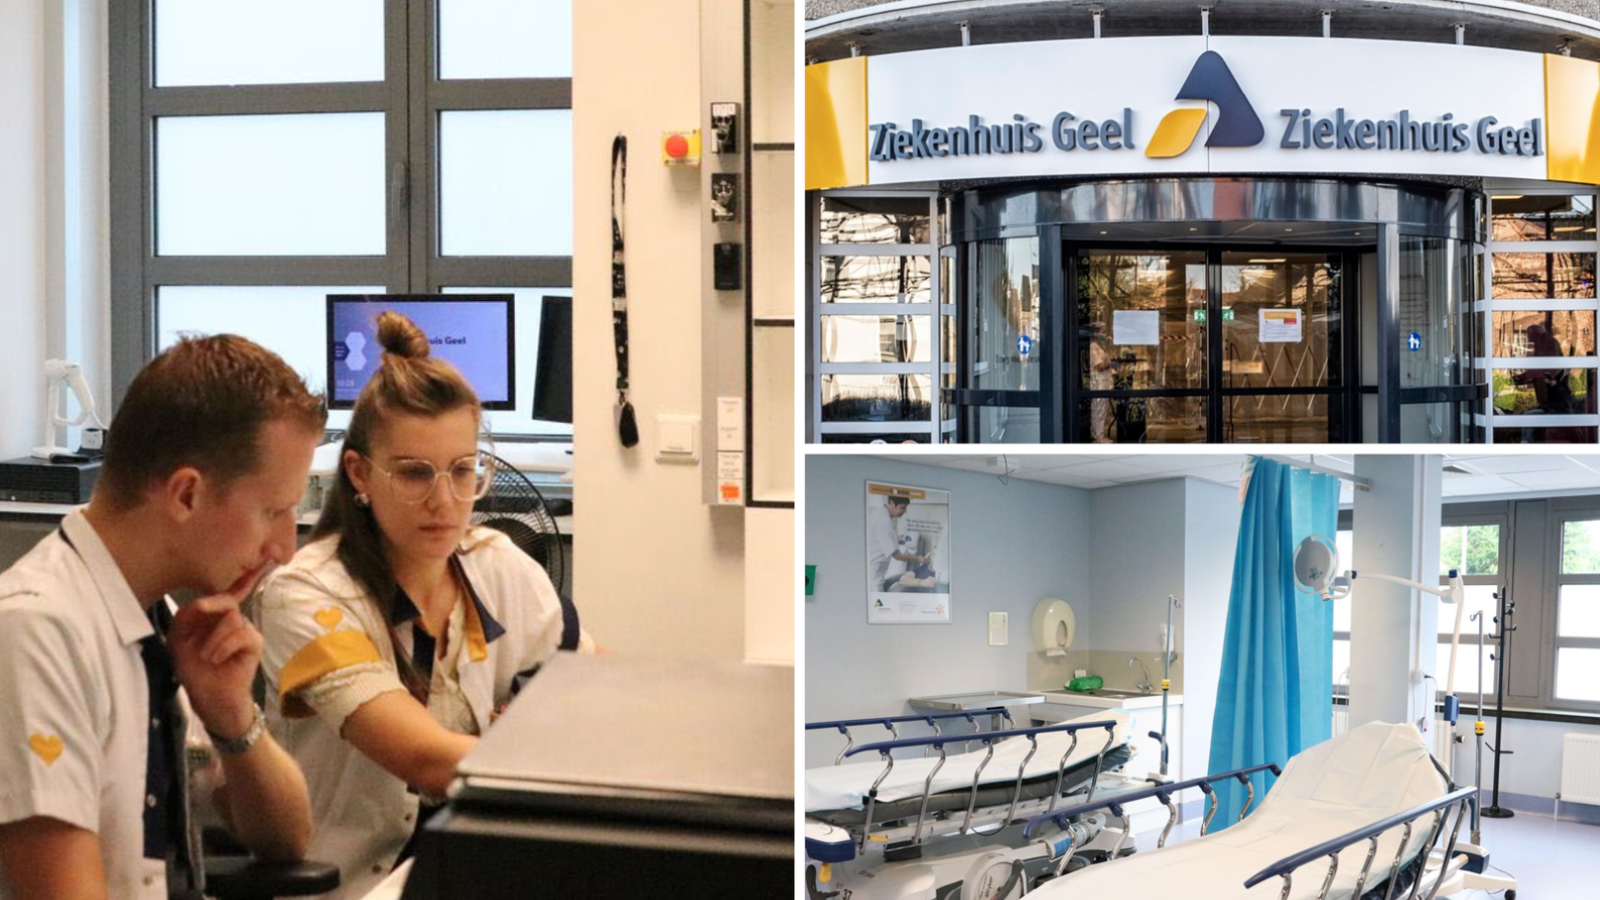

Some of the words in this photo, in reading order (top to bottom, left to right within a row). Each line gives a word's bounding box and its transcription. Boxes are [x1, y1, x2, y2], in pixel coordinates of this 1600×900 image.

[869, 113, 1043, 161] Ziekenhuis
[1052, 107, 1135, 152] Geel
[1280, 107, 1471, 153] Ziekenhuis
[1477, 115, 1545, 157] Geel
[445, 336, 467, 345] Geel
